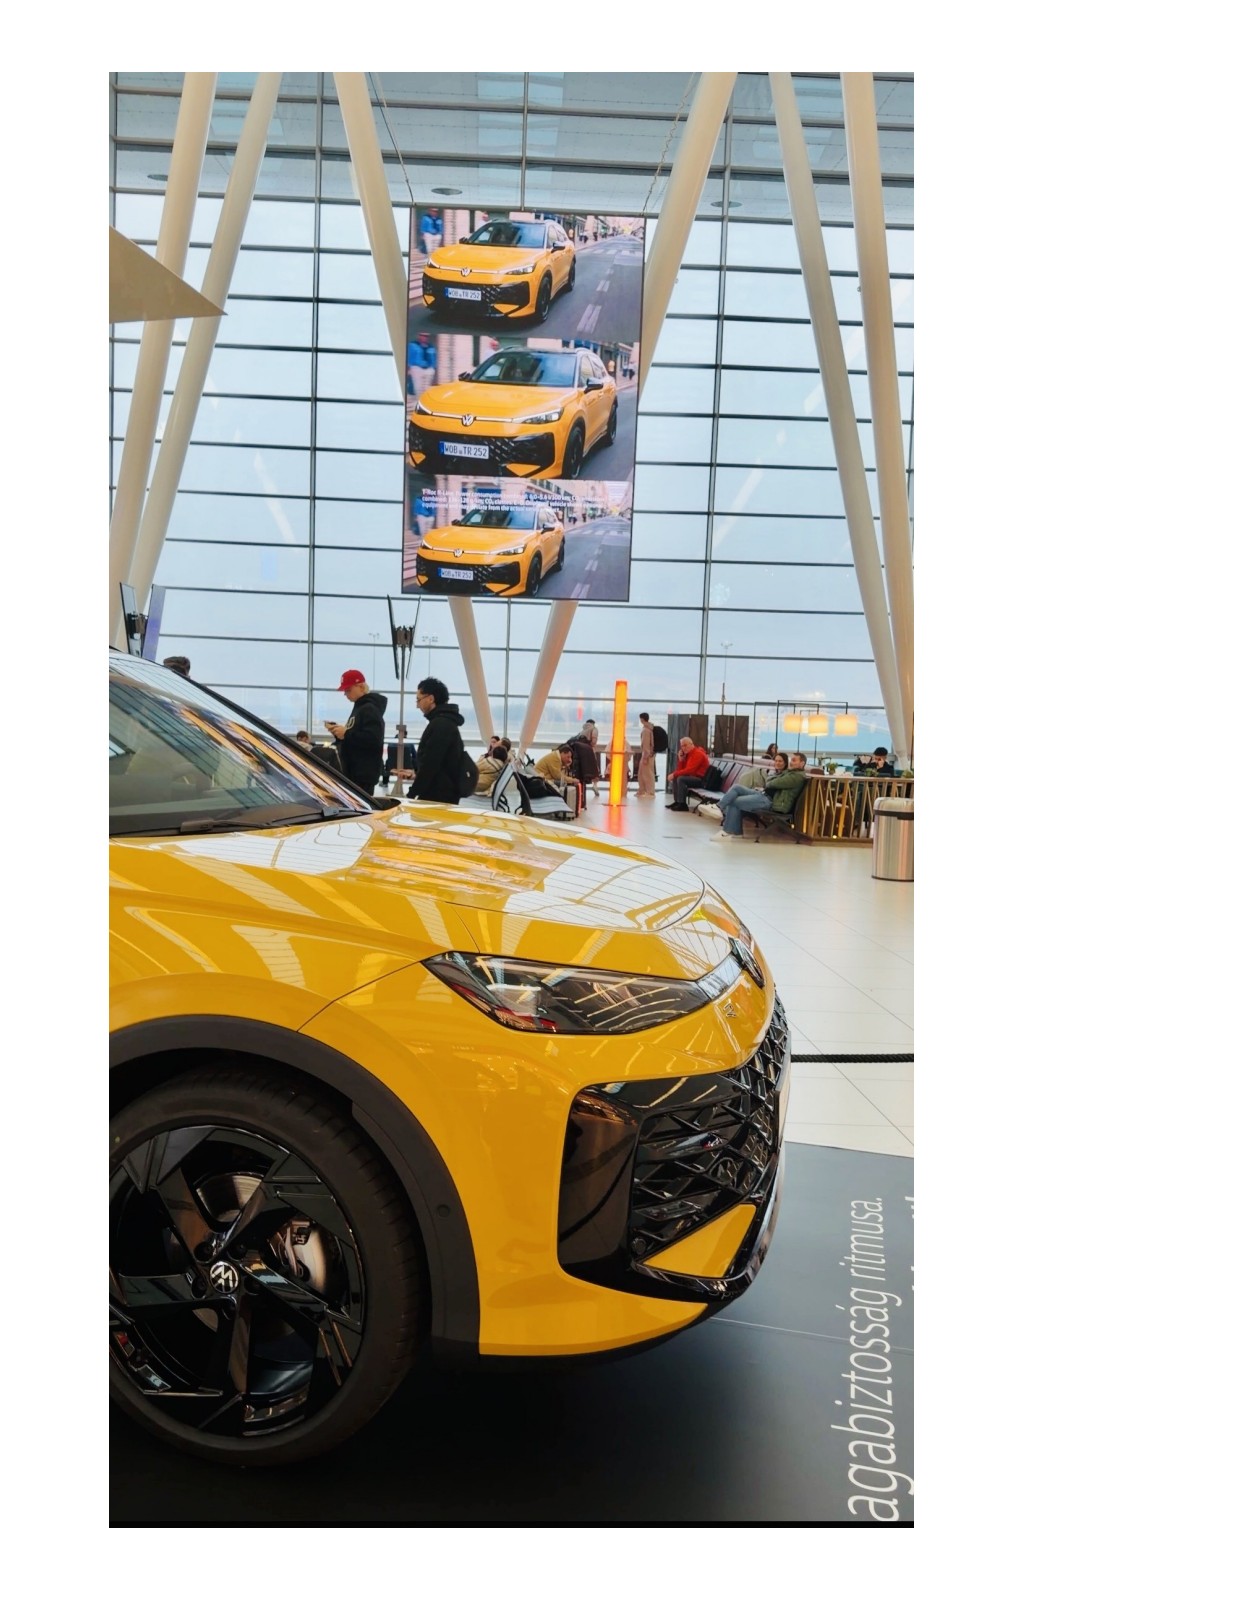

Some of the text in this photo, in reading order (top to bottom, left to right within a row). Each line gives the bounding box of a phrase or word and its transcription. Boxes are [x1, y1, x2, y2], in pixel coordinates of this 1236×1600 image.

[470, 291, 480, 299] 252
[444, 444, 488, 457] WOB TR 252
[839, 1197, 886, 1281] ritmusa.
